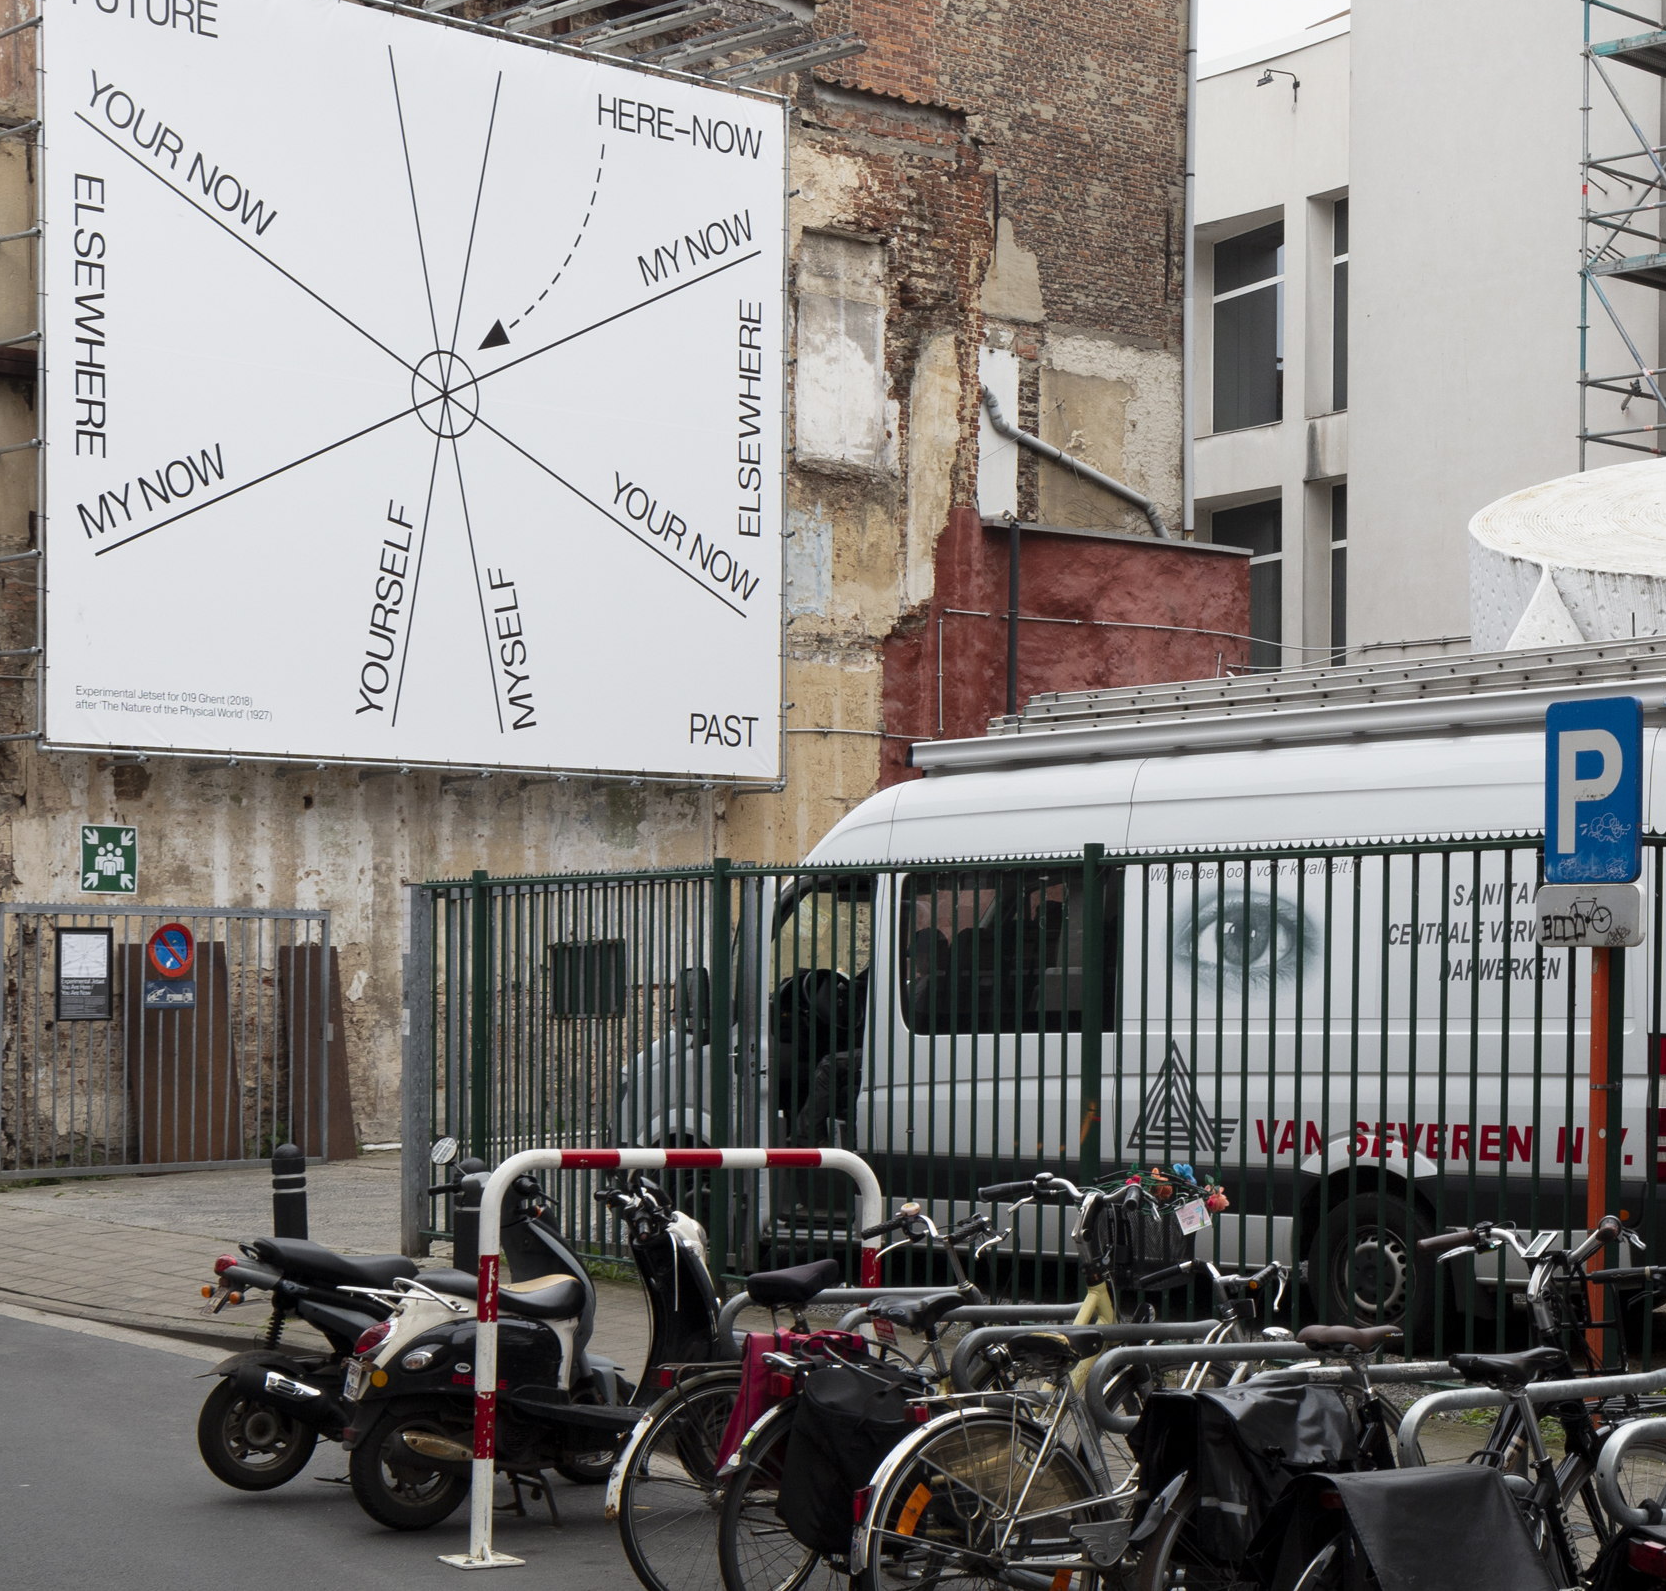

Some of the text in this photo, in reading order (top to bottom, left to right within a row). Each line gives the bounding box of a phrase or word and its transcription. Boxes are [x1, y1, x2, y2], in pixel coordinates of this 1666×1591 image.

[88, 69, 278, 236] YOUR NOW
[598, 94, 763, 160] HERE-NOW
[637, 210, 752, 287] MY NOW
[74, 173, 106, 459] ELSEWHERE
[738, 299, 762, 538] ELSEWHERE
[76, 443, 226, 540] MY NOW
[611, 471, 761, 602] YOUR NOW
[355, 499, 414, 716] YOURSELF
[486, 567, 537, 731] MYSELF
[75, 685, 253, 707] Experimental Jetset for 019 Ghent (2018)
[75, 700, 97, 710] after
[121, 702, 151, 713] Nature
[153, 703, 162, 714] of
[163, 704, 178, 715] the
[180, 706, 216, 718] Physical
[246, 710, 273, 722] (1927)
[690, 712, 760, 749] PAST
[1557, 728, 1624, 854] P
